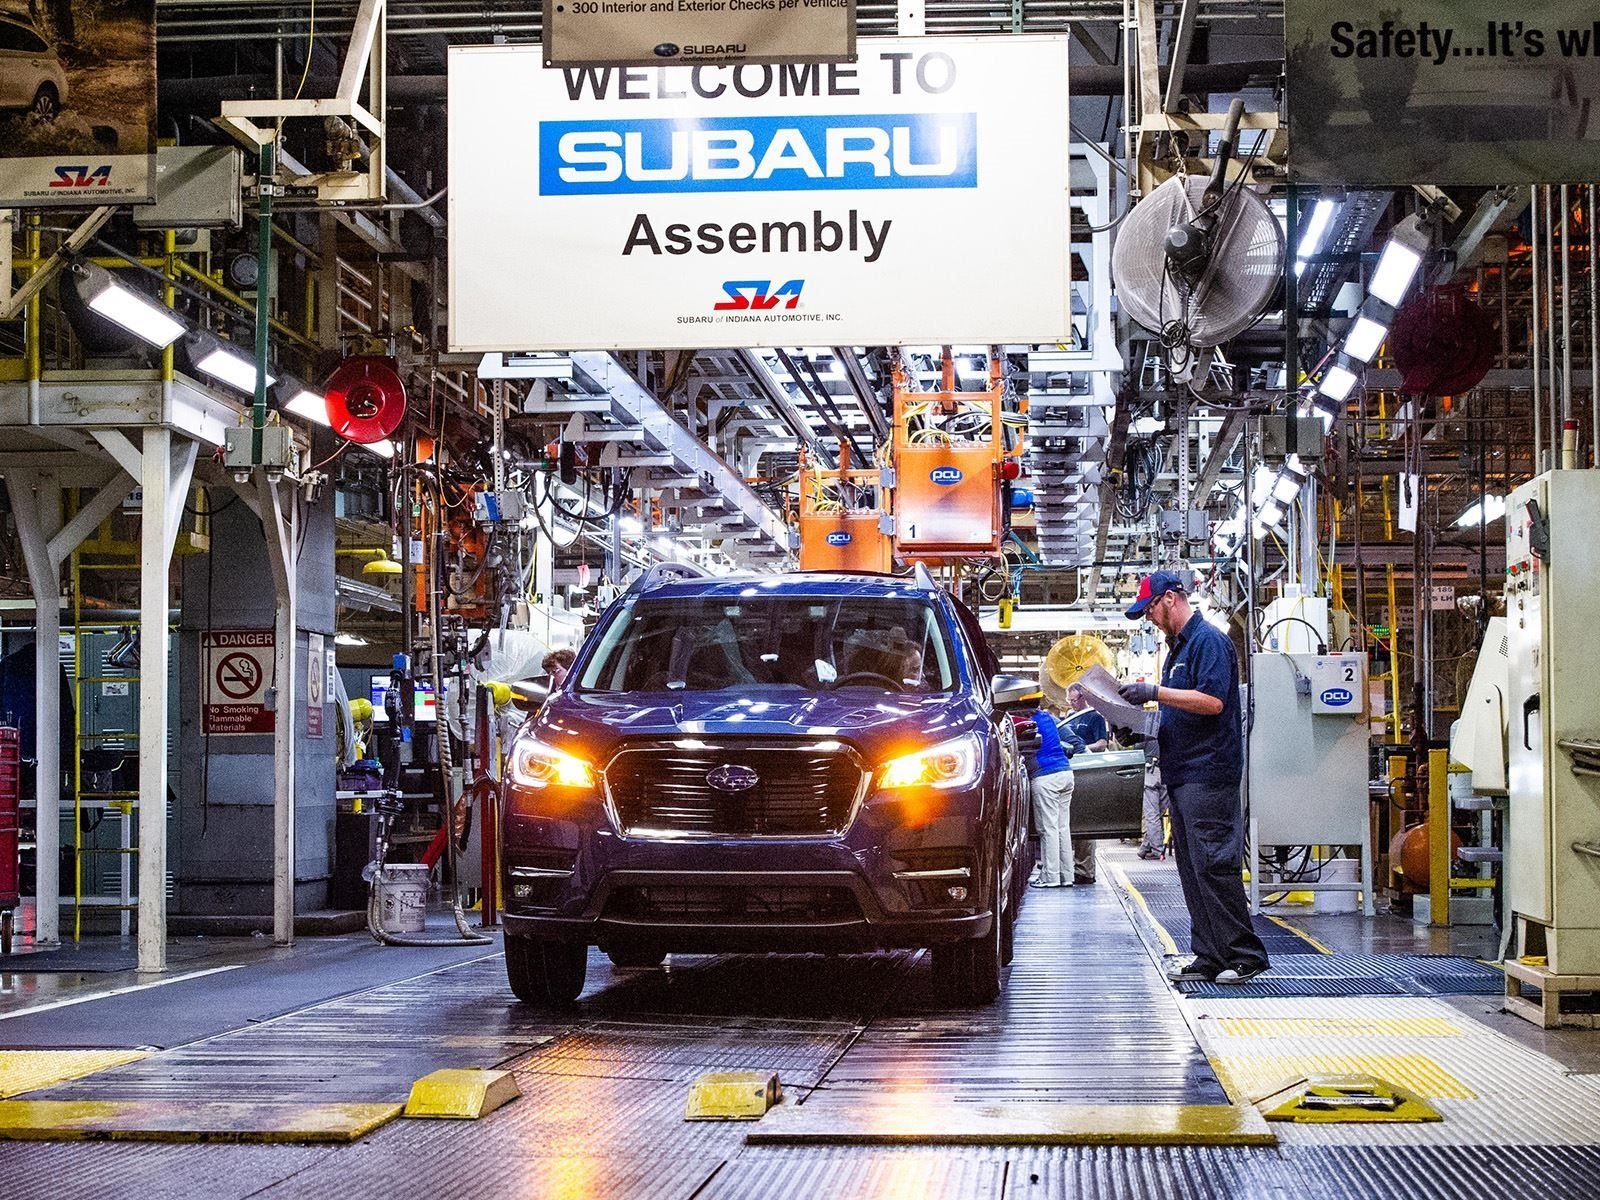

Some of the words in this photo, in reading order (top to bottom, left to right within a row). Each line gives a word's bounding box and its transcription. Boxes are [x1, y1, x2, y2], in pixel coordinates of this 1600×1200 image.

[572, 2, 598, 14] 300
[602, 1, 647, 13] Interior
[650, 0, 674, 12] and
[678, 0, 726, 12] Exterior
[729, 0, 775, 10] Checks
[779, 0, 799, 11] per
[683, 44, 746, 54] SUBARU
[562, 62, 860, 101] WELCOME
[880, 51, 958, 95] TO
[558, 126, 958, 184] SUBARU
[621, 209, 893, 263] Assembly
[677, 315, 714, 324] SUBARU
[716, 315, 724, 323] of
[725, 315, 761, 324] INDIANA
[763, 313, 824, 322] AUTOMOTIVE,
[826, 313, 843, 321] INC.
[909, 524, 916, 539] 1
[220, 633, 274, 646] DANGER
[1344, 667, 1354, 682] 2
[208, 705, 219, 714] No
[223, 704, 259, 715] Smoking
[208, 714, 252, 723] Flammable
[208, 723, 246, 732] Materials
